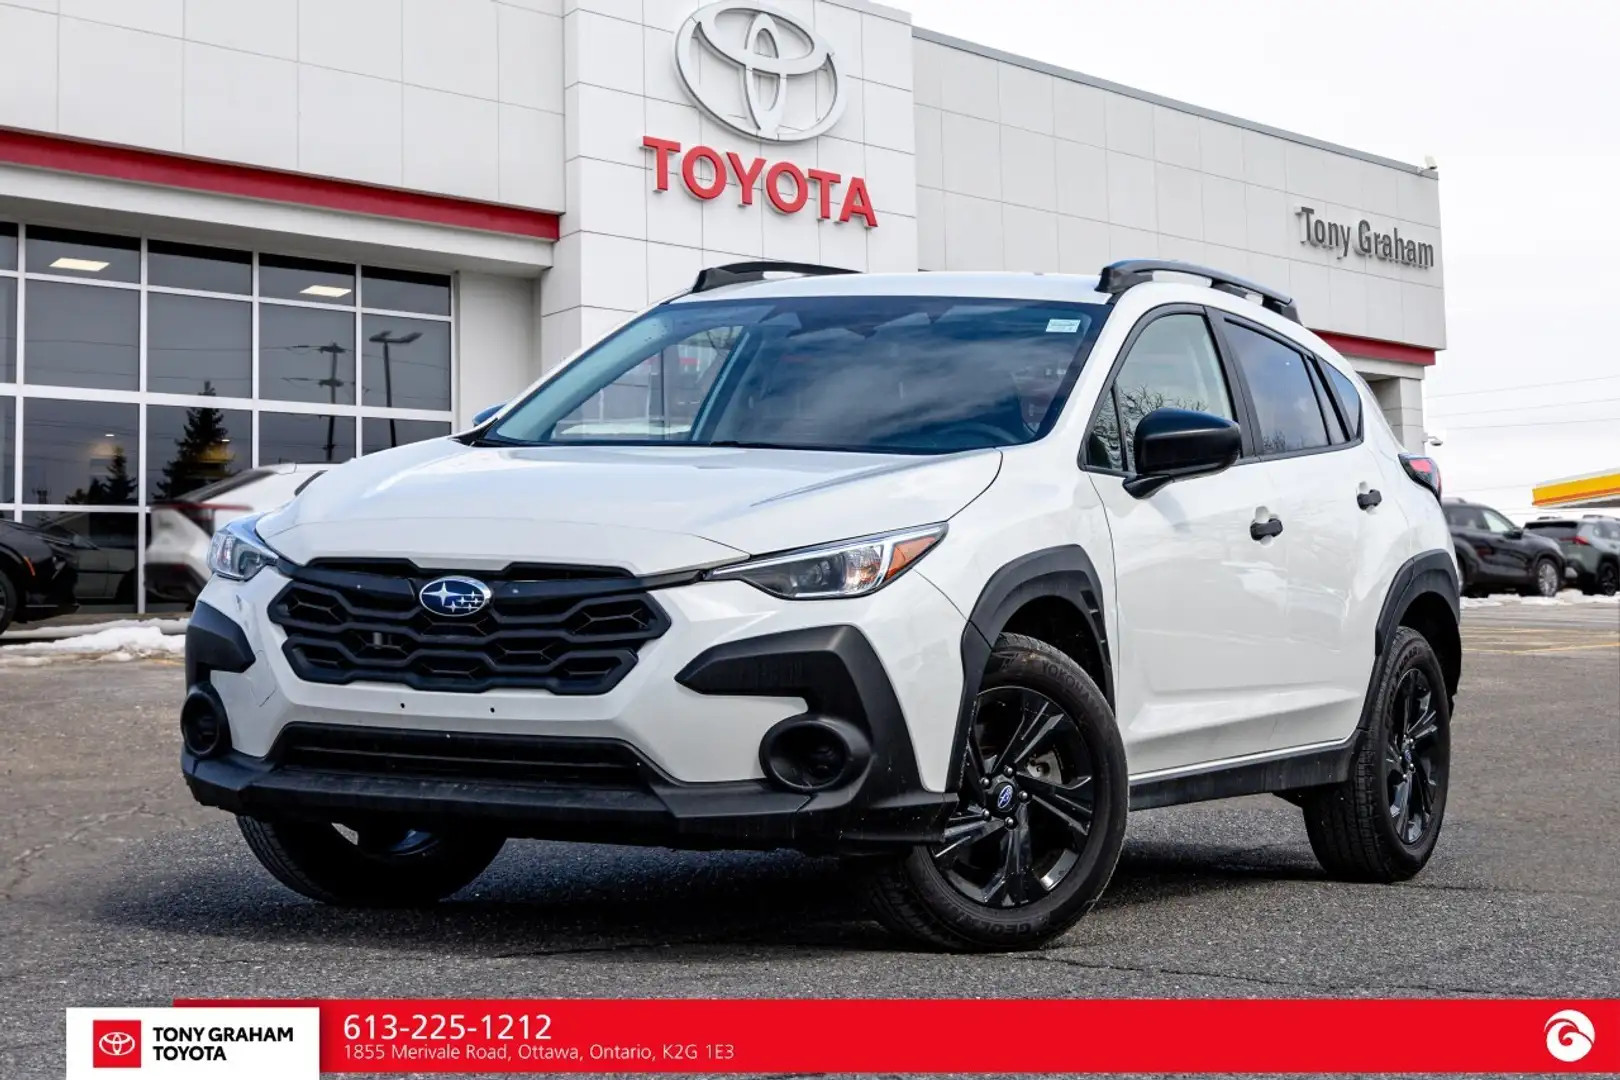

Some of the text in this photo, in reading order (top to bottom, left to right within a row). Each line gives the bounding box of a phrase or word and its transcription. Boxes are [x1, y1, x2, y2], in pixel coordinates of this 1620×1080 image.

[642, 135, 878, 228] TOYOTA
[1299, 206, 1434, 268] Tony Graham
